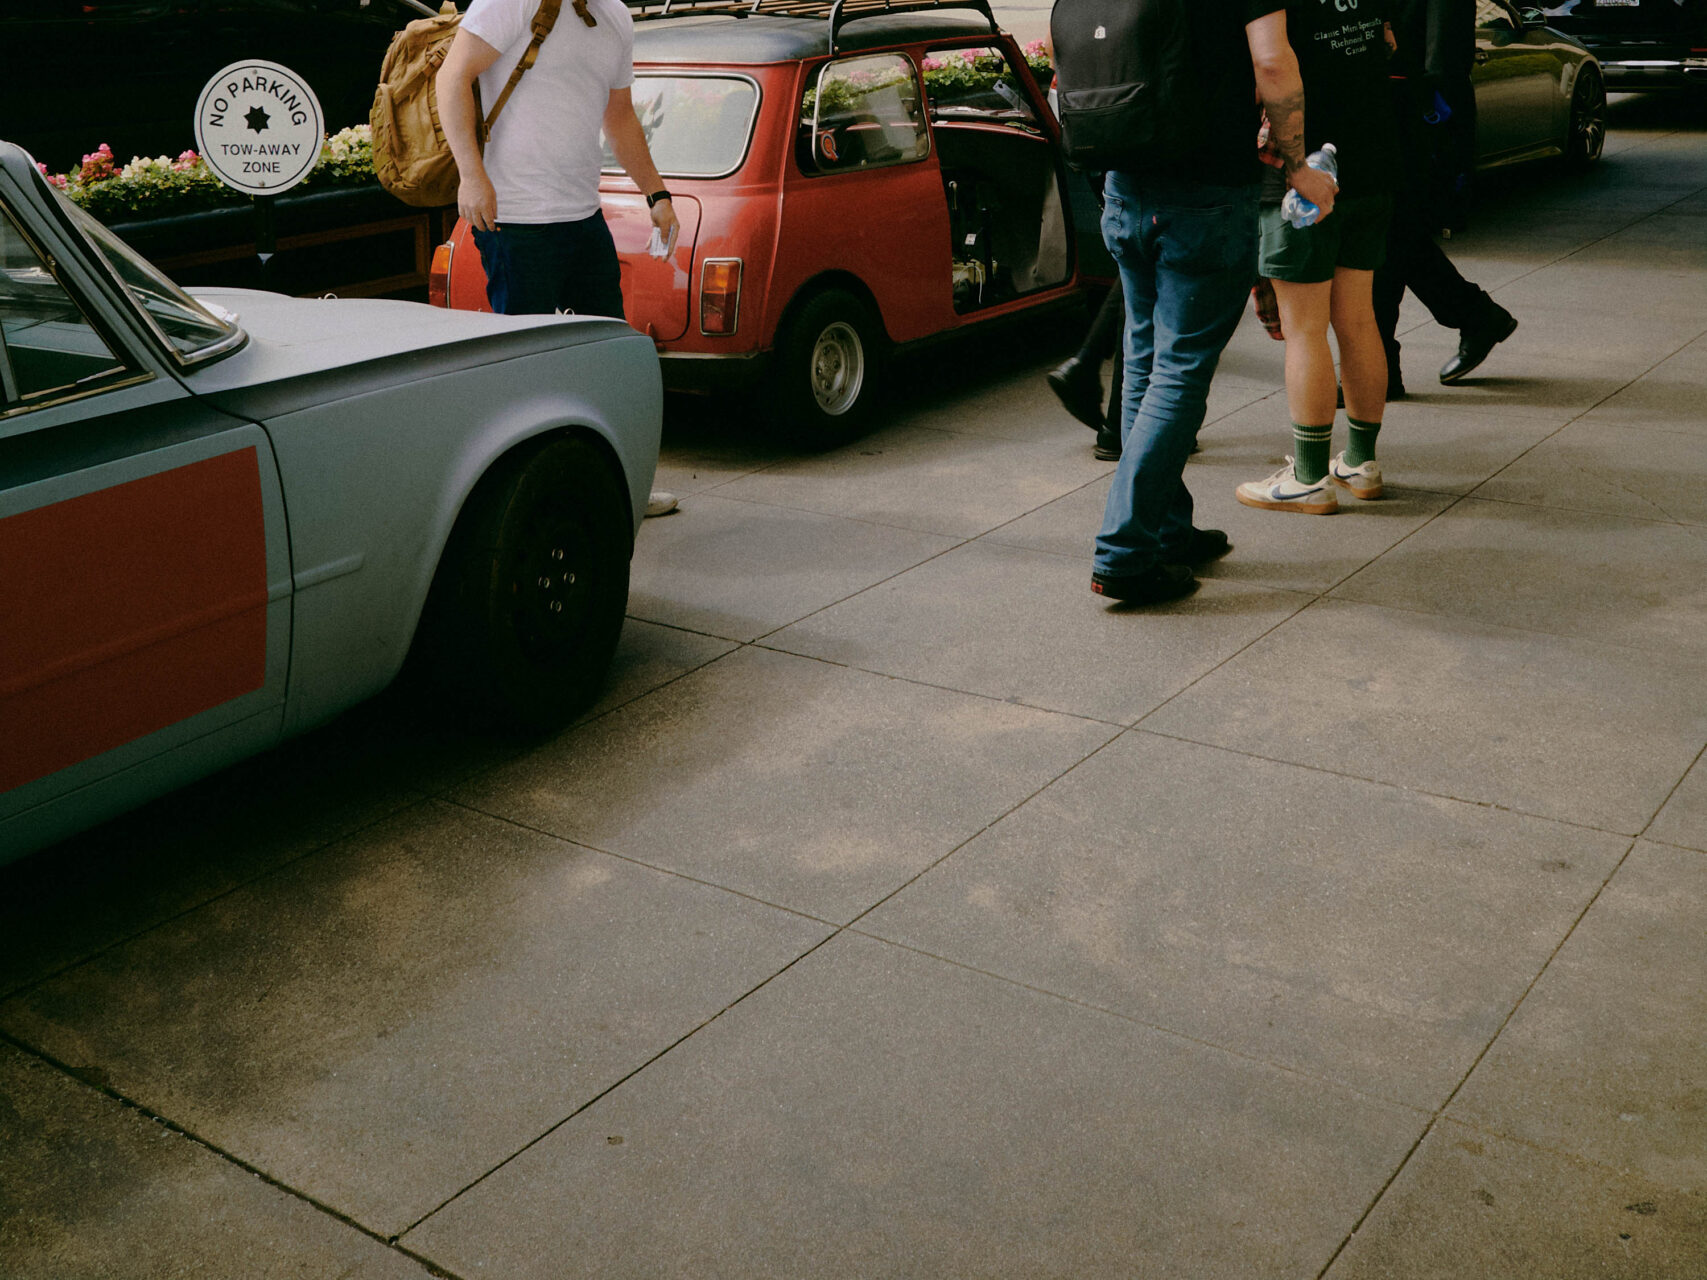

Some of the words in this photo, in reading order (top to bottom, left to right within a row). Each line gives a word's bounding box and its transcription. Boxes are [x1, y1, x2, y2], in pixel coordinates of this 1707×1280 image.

[209, 97, 229, 127] NO
[227, 76, 307, 126] PARKING
[221, 144, 301, 156] TOW-AWAY
[242, 162, 281, 173] ZONE
